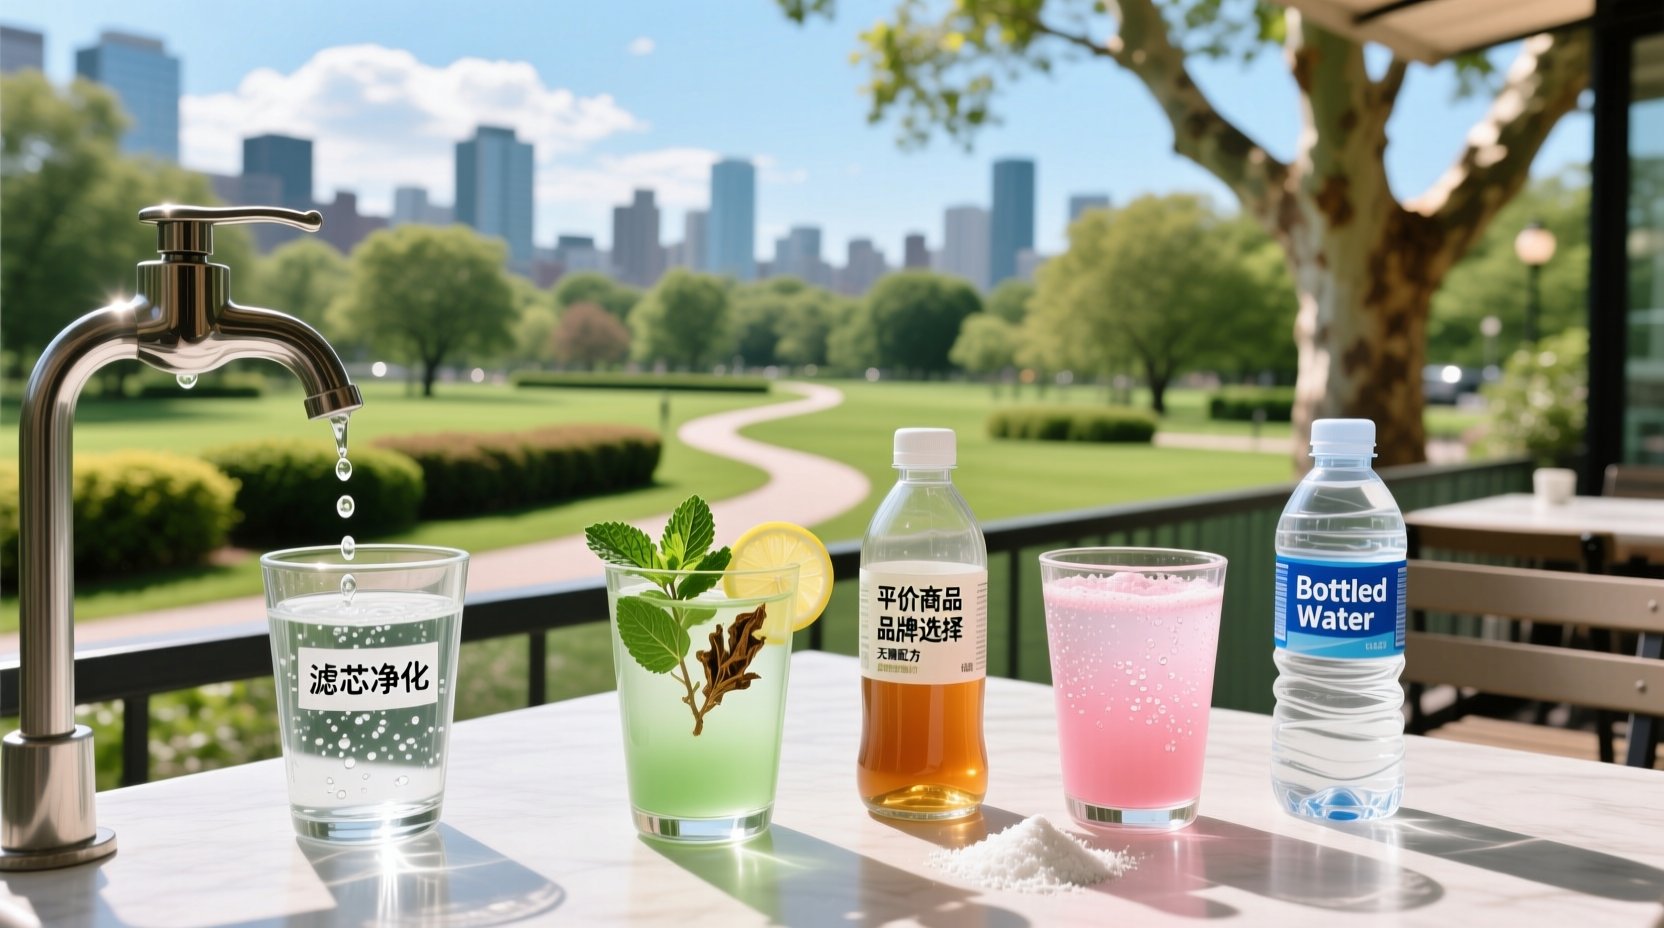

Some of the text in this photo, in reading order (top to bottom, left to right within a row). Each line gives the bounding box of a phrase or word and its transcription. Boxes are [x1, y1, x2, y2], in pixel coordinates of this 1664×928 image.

[877, 585, 962, 612] 平价商品
[1296, 575, 1387, 603] Bottled
[877, 616, 964, 643] 品牌选择
[1297, 604, 1375, 630] Water
[310, 660, 429, 695] 滤芯净化
